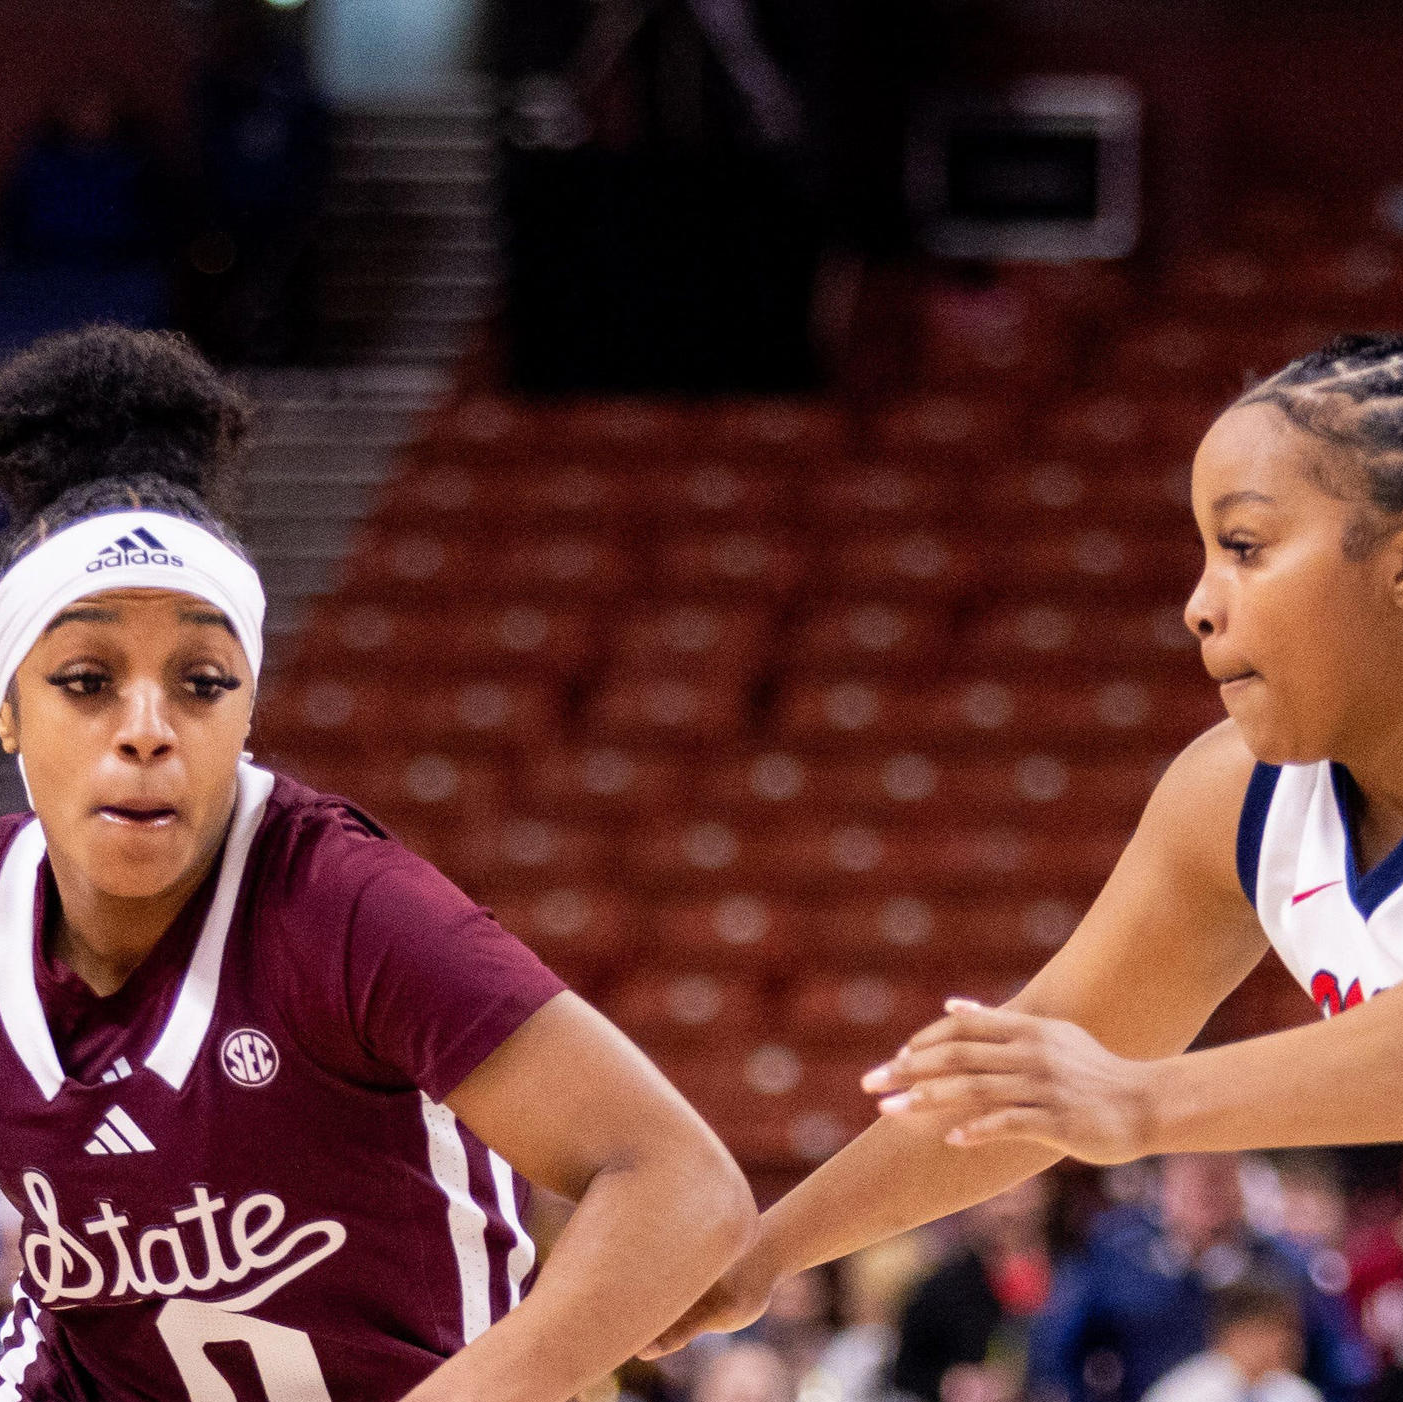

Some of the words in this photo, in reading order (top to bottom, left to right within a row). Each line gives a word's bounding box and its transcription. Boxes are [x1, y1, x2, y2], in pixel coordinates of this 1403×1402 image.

[85, 549, 185, 574] adidas
[226, 1034, 273, 1081] SEC
[21, 1168, 348, 1313] State
